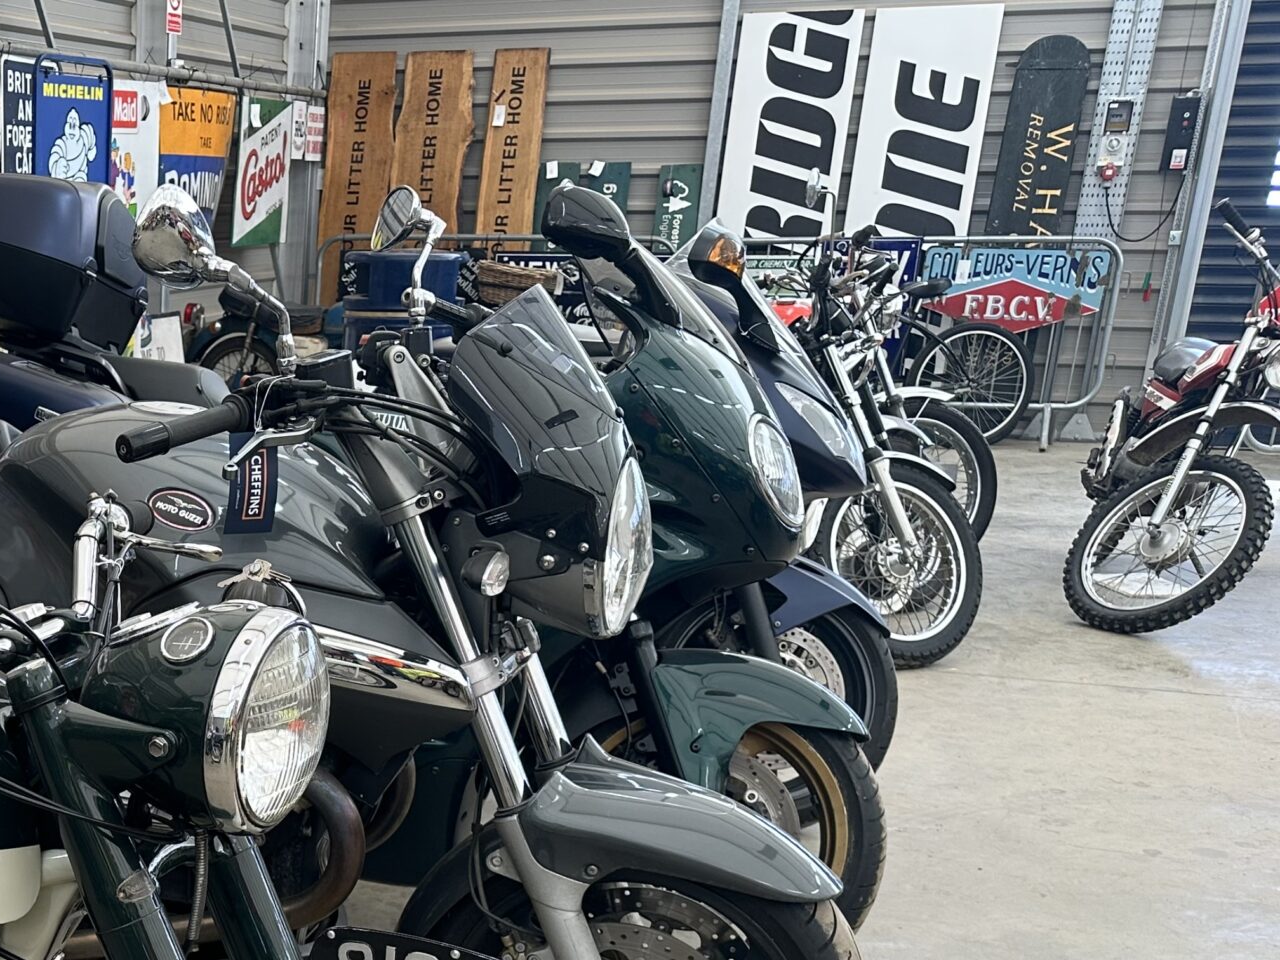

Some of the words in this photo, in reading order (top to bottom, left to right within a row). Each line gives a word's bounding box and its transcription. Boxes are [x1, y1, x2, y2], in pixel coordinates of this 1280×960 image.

[43, 82, 104, 101] MICHELIN
[113, 96, 137, 122] Maid
[171, 101, 195, 121] TAKE
[200, 103, 213, 124] NO
[354, 78, 371, 133] HOME
[426, 68, 444, 126] HOME
[507, 66, 527, 125] HOME
[200, 136, 212, 149] TAKE
[420, 135, 438, 204] LITTER
[497, 134, 519, 204] LITTER
[1012, 113, 1045, 213] REMOVAL
[241, 130, 287, 221] Castrol
[347, 141, 365, 206] LITTER
[155, 501, 179, 514] MOTO
[178, 509, 203, 525] GUZZI
[248, 455, 262, 515] CHEFFINS
